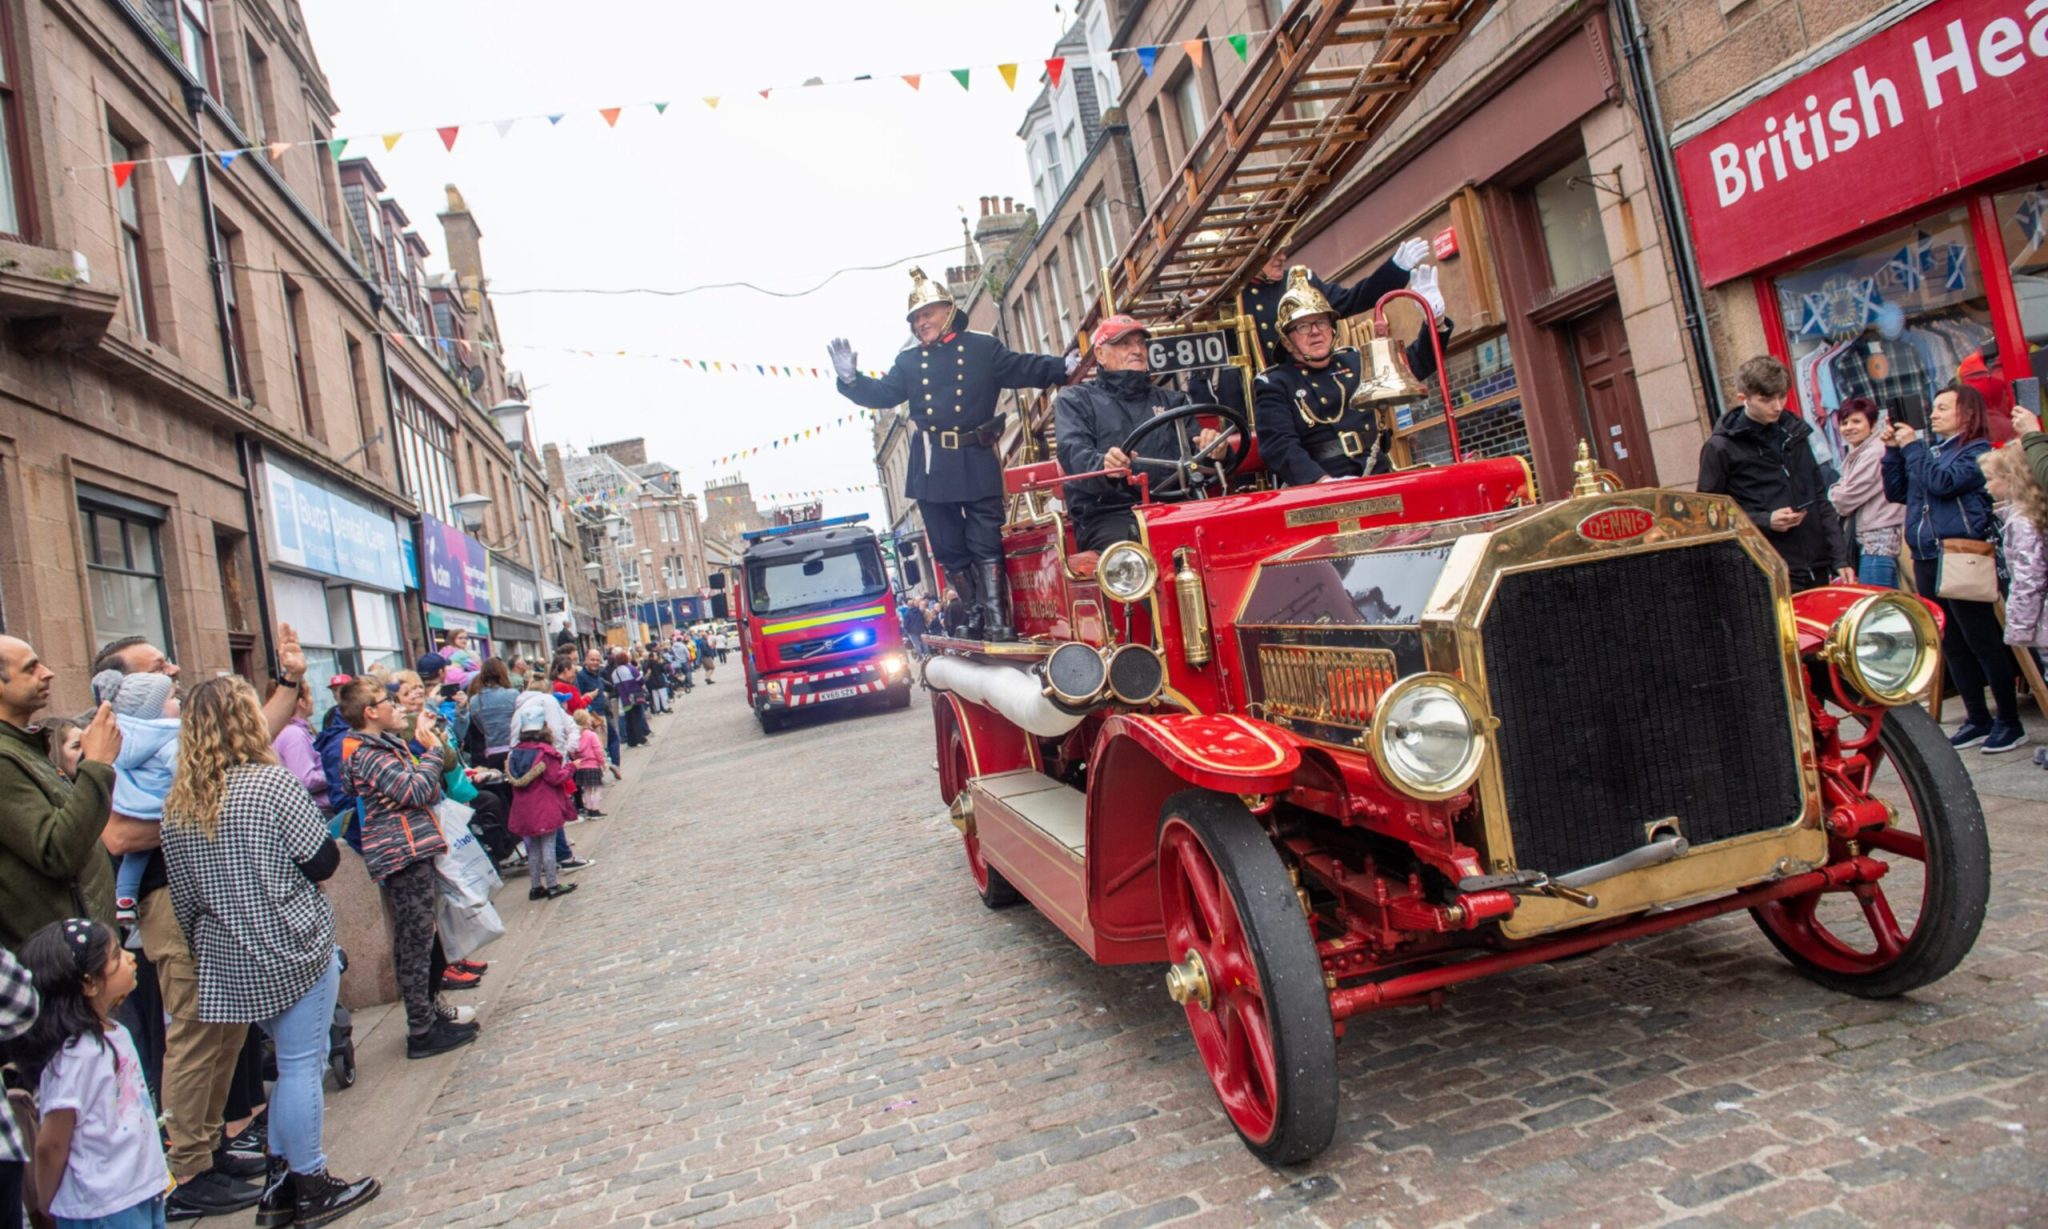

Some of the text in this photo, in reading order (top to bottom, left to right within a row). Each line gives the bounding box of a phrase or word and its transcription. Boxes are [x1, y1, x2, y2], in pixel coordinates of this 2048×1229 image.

[1709, 64, 1904, 208] British
[1148, 336, 1223, 369] G-810
[1588, 509, 1648, 539] DENNIS
